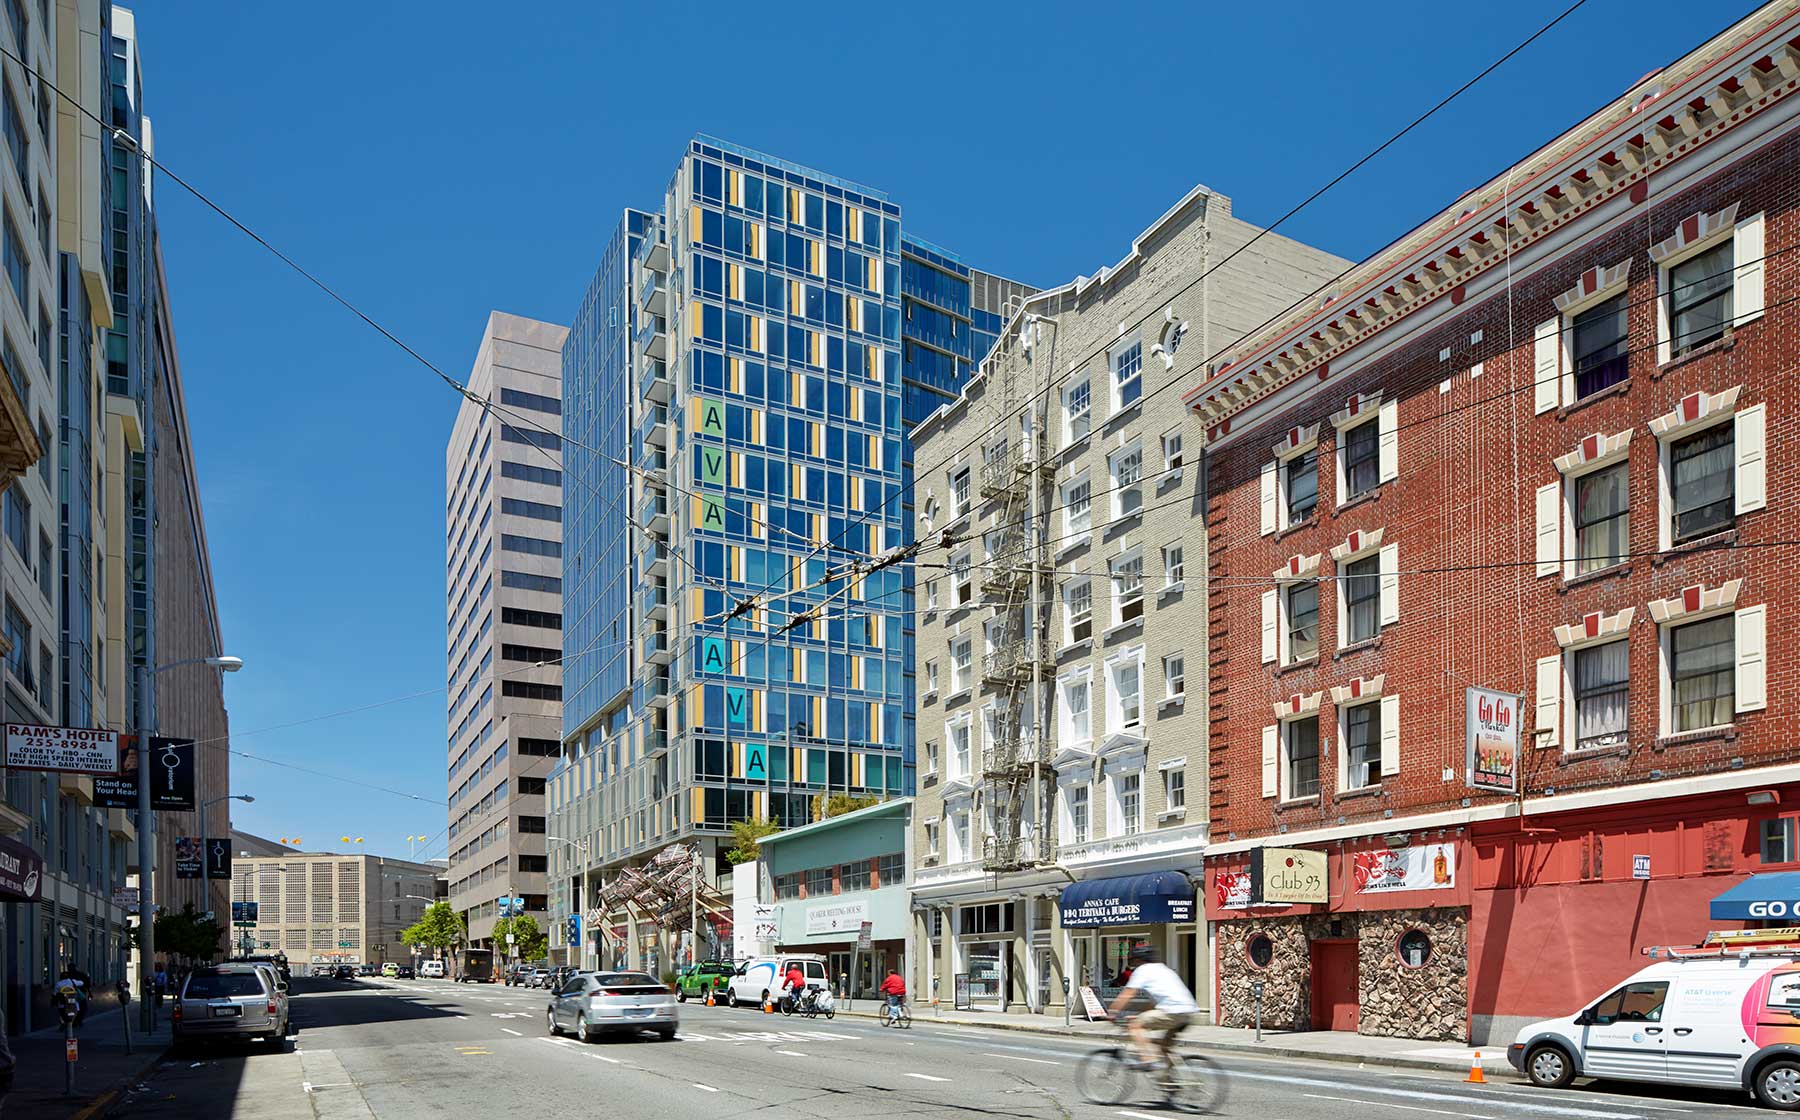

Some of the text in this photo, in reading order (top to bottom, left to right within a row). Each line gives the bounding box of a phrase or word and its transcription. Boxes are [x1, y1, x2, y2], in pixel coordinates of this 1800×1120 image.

[704, 406, 723, 525] AVA
[1479, 695, 1510, 728] Go Go
[9, 725, 113, 742] RAM'S HOTEL
[26, 737, 97, 750] 255-8984
[19, 746, 43, 754] COLOR
[28, 759, 51, 767] RATES
[58, 761, 113, 770] DAILY/WEEKLY
[30, 753, 49, 761] HIGH
[52, 755, 75, 763] SPEED
[76, 757, 112, 765] INTERNET
[96, 780, 119, 788] Stand
[96, 787, 137, 796] Your Head
[1634, 858, 1650, 870] ATM
[1270, 870, 1321, 892] Club 93
[1083, 897, 1120, 908] ANNA'S CAFE
[1078, 906, 1106, 918] TERIYAKI
[1111, 903, 1140, 916] BURGERS
[1748, 901, 1787, 917] GO
